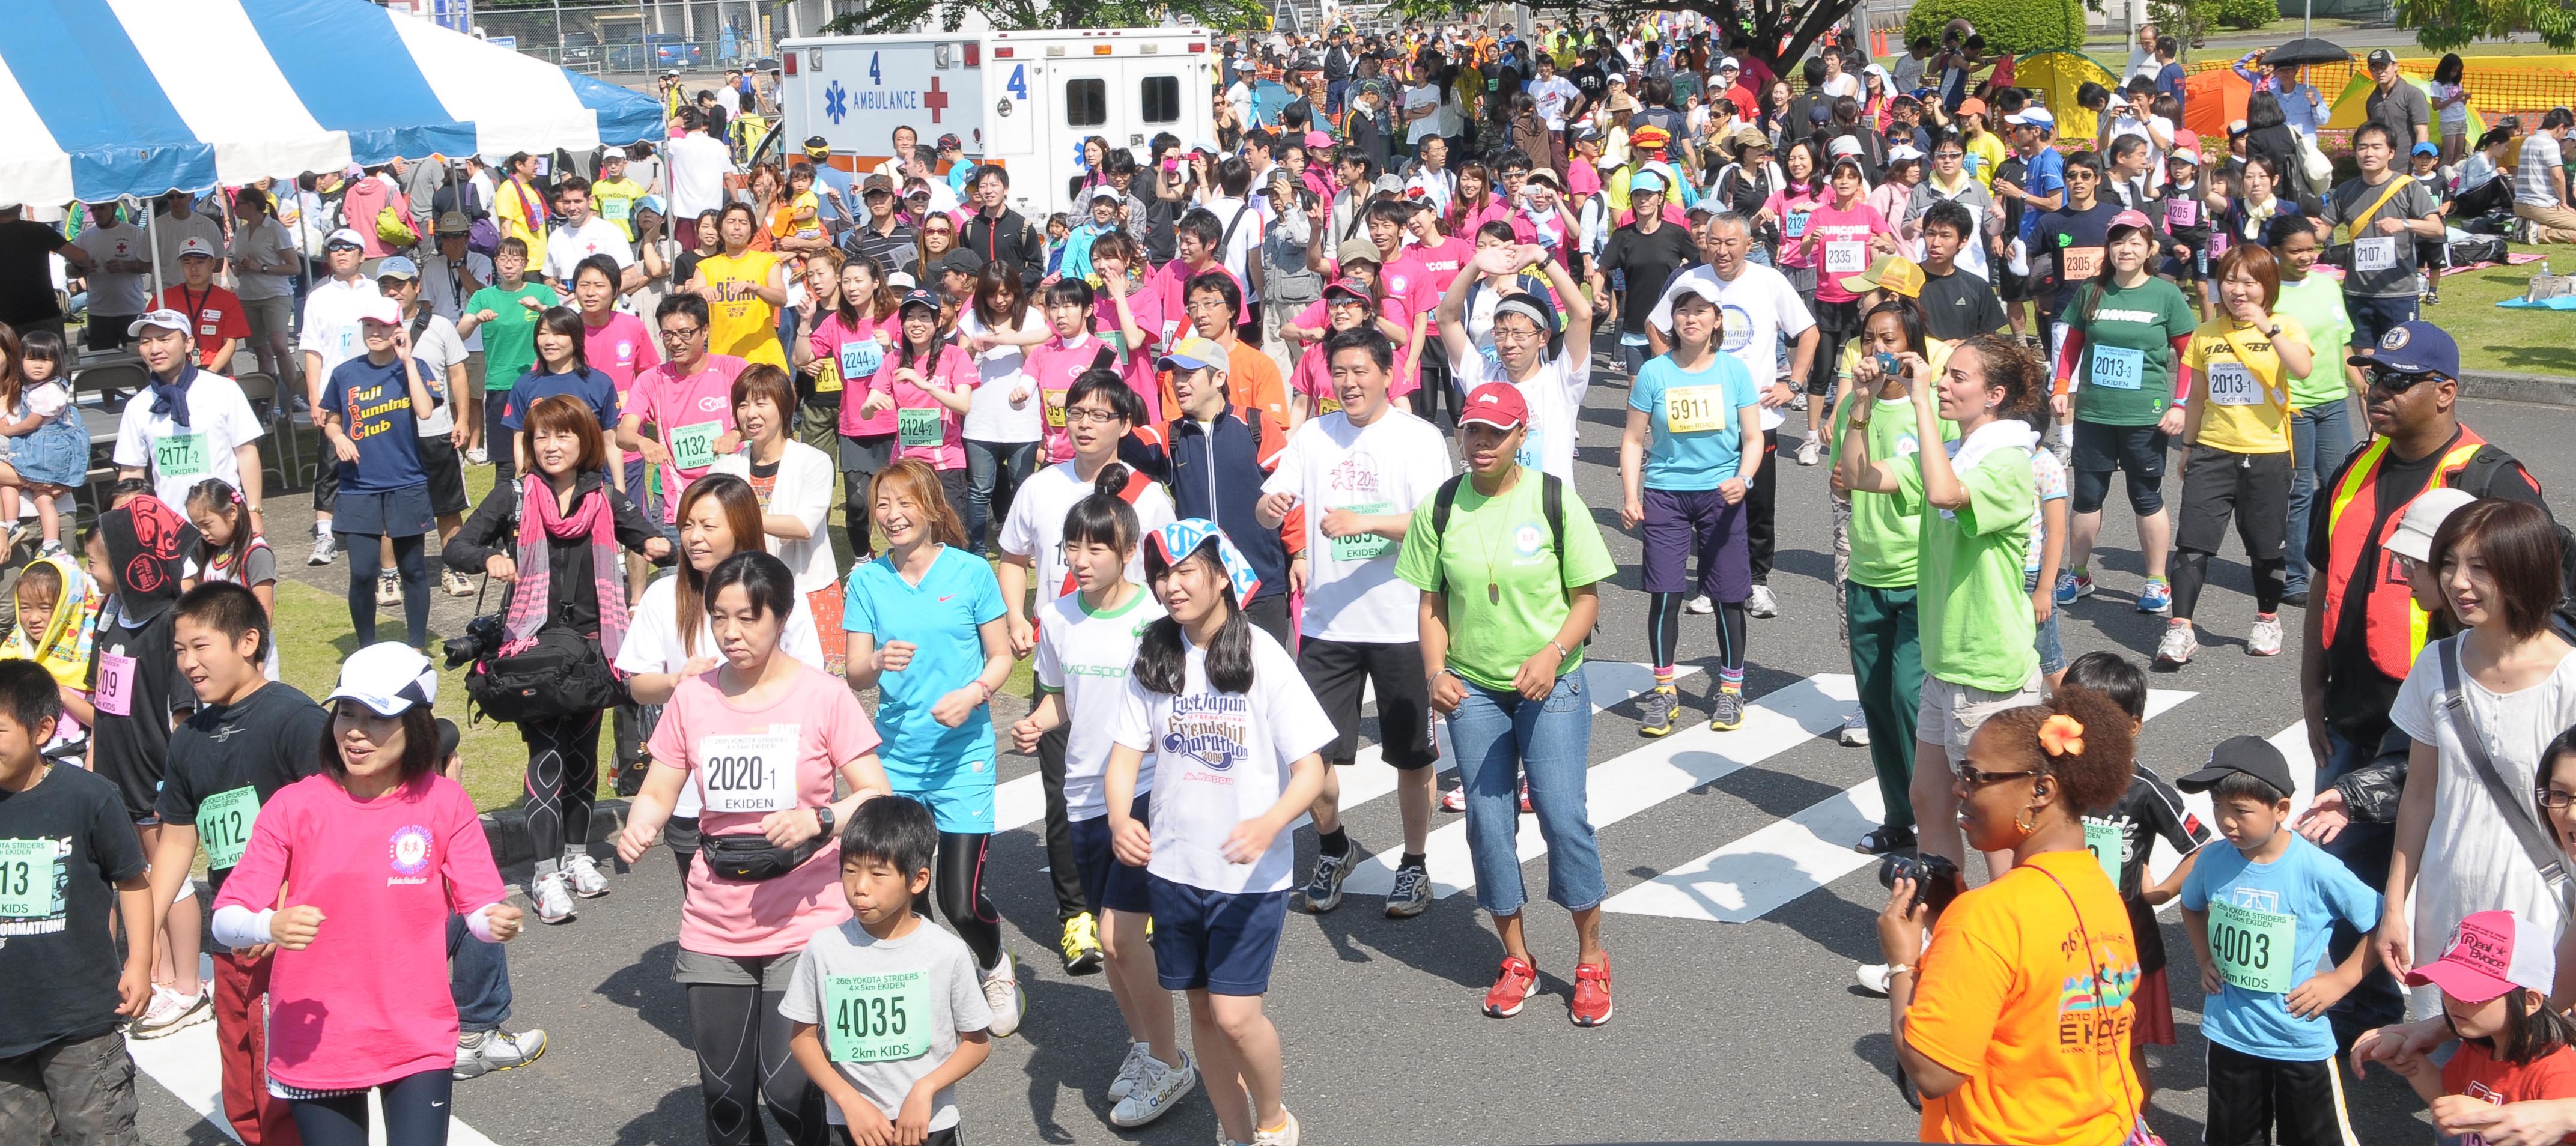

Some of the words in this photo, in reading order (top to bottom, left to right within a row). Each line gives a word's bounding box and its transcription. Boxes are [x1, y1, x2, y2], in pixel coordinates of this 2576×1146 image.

[870, 51, 880, 85] 4
[1007, 64, 1026, 99] 4
[854, 91, 916, 110] AMBULANCE
[2357, 247, 2386, 262] 2107-1
[2213, 342, 2271, 354] RAGER
[843, 351, 876, 369] 2244-3
[2095, 356, 2131, 378] 2013-3
[2101, 378, 2128, 389] EKIDEN
[2211, 373, 2251, 394] 2013-1
[348, 386, 382, 405] Fuji
[348, 396, 411, 423] Running
[1672, 399, 1709, 420] 5911
[350, 419, 391, 440] Club
[900, 418, 932, 436] 2124-2
[159, 446, 198, 465] 2177-2
[688, 458, 715, 467] EKIDEN
[1358, 471, 1379, 487] 20th
[1347, 548, 1382, 557] EKIDEN
[102, 700, 116, 711] KIDS
[1201, 751, 1223, 763] 2009
[708, 756, 775, 792] 2020-1
[1198, 772, 1234, 785] Kappa
[725, 798, 774, 809] EKIDEN
[204, 811, 246, 850] 4112
[212, 857, 226, 869] 2km
[2, 903, 29, 914] KIDS
[2229, 904, 2250, 917] YOKOTA
[2252, 912, 2286, 923] STRIDERS
[2246, 918, 2273, 928] EKIDEN
[2213, 922, 2270, 969] 4003
[853, 975, 881, 984] YOKOTA
[884, 972, 919, 983] STRIDERS
[878, 981, 905, 990] EKIDEN
[2222, 968, 2237, 983] 2km
[2240, 974, 2269, 989] KIDS
[837, 996, 907, 1038] 4035
[852, 1047, 878, 1059] 2km
[881, 1044, 910, 1056] KIDS
[1150, 1078, 1183, 1107] adidas
